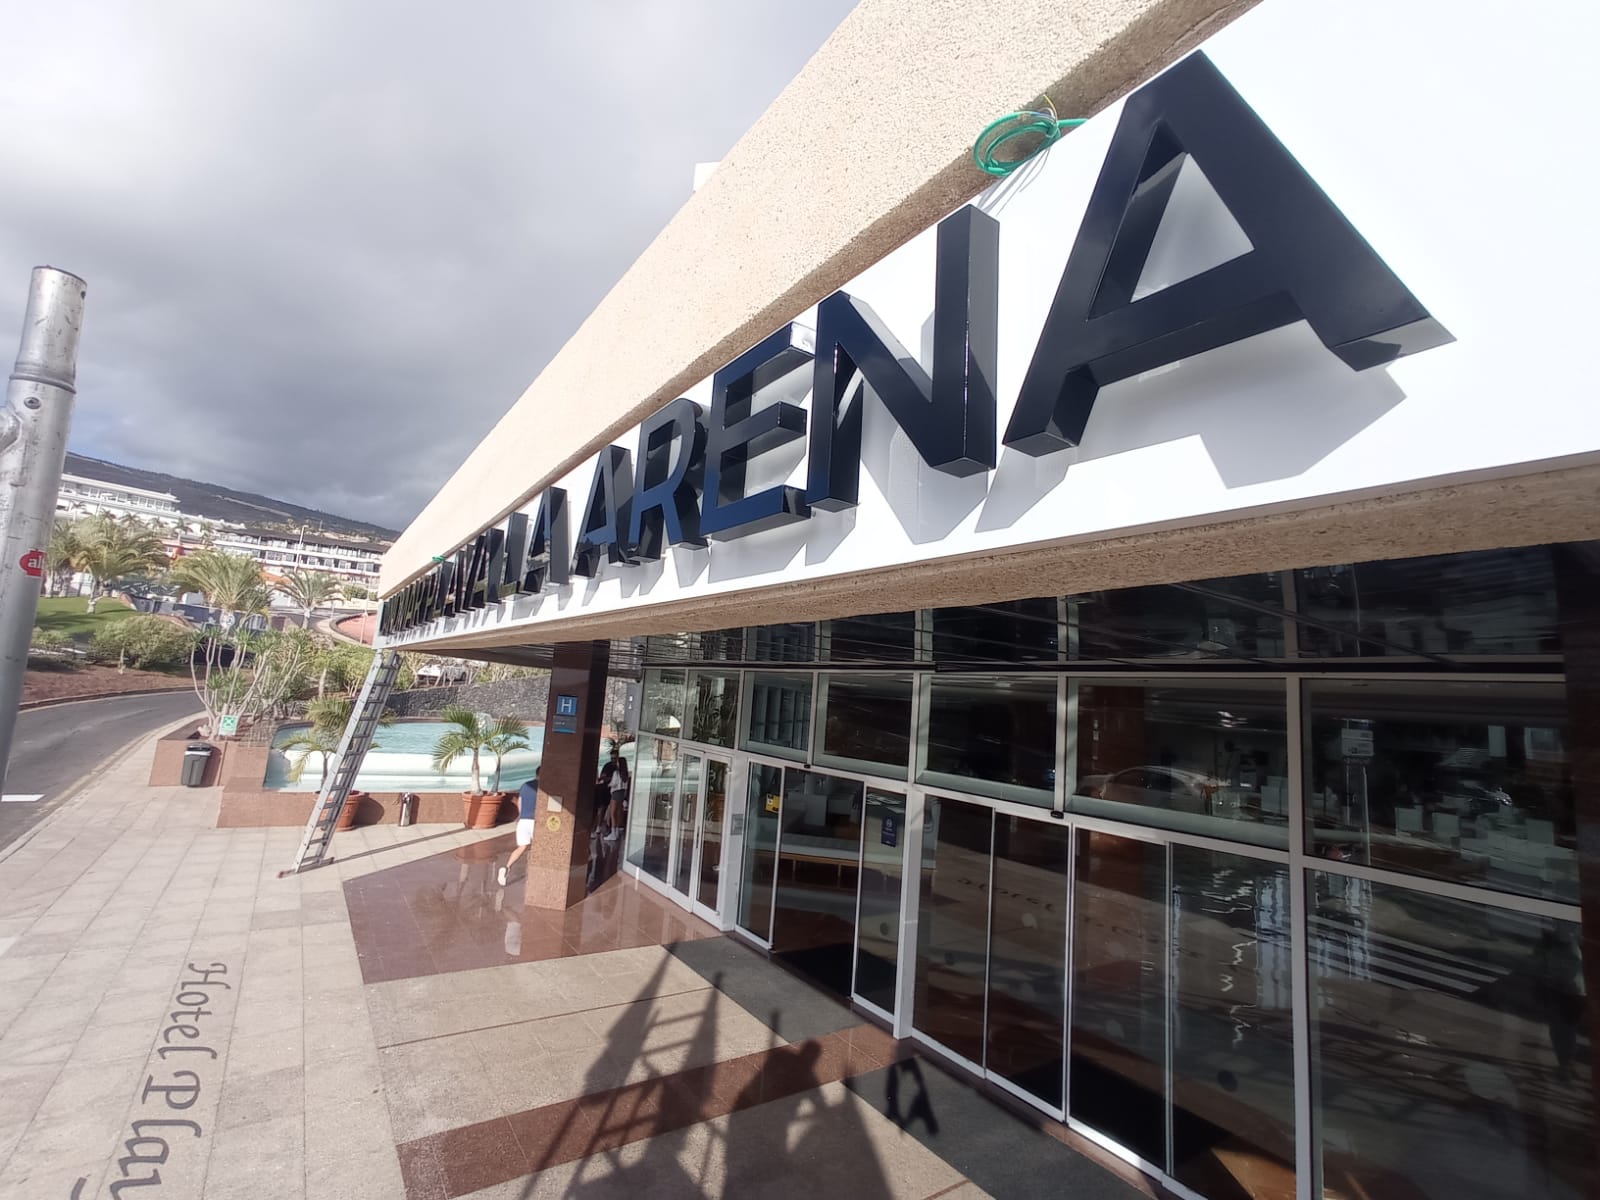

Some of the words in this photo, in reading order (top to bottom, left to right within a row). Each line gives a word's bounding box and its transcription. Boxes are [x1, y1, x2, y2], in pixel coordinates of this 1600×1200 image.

[500, 486, 568, 596] LA
[573, 50, 1456, 580] ARENA
[561, 698, 572, 713] H
[158, 962, 231, 1059] Hotel
